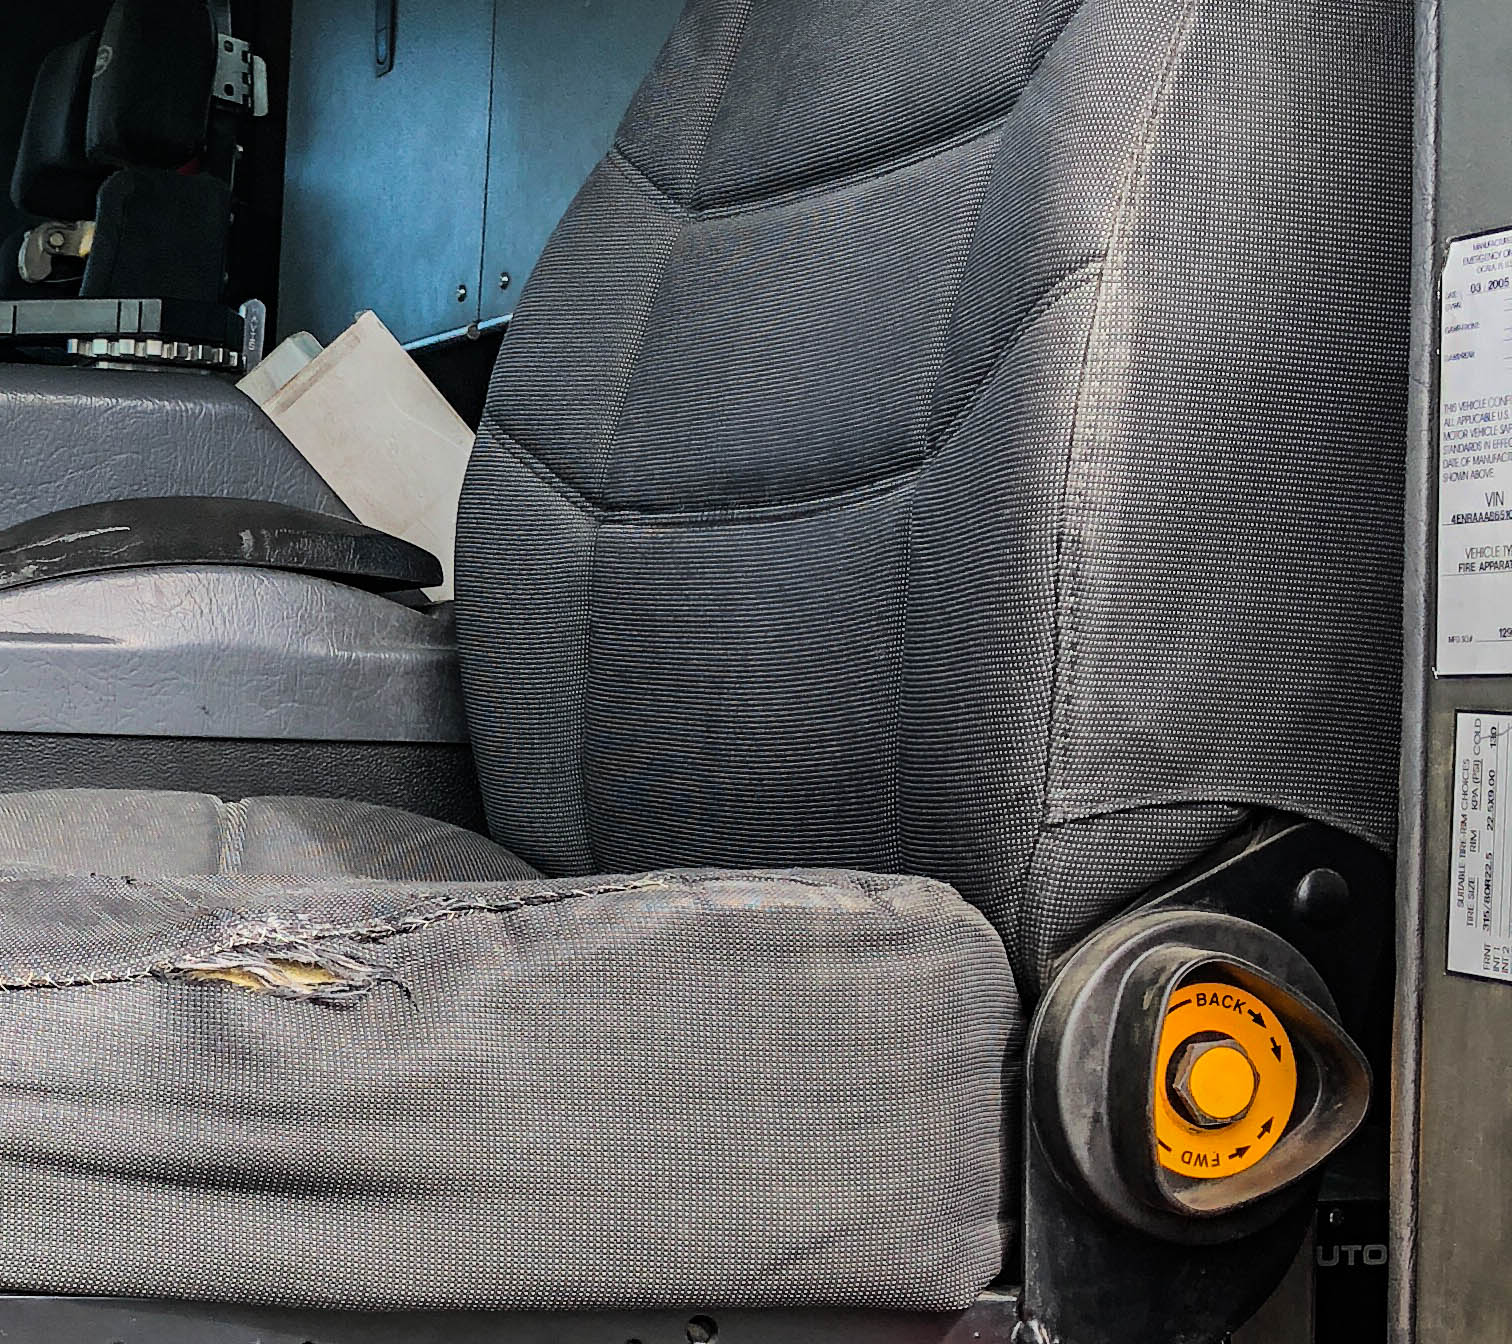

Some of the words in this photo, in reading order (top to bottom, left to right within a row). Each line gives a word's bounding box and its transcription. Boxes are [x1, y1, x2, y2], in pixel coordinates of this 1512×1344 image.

[1488, 277, 1509, 291] 2005
[1459, 398, 1486, 411] VEHICLE
[1470, 424, 1497, 438] VEHICLE
[1484, 490, 1505, 507] VIN
[1465, 545, 1500, 560] VEHICLE
[1458, 562, 1476, 573] FIRE
[1473, 718, 1481, 755] COLD
[1456, 863, 1465, 908] SUITABLE
[1461, 758, 1469, 810] CHOICES
[1467, 876, 1475, 900] SIZE
[1466, 903, 1474, 927] TIRE
[1482, 943, 1490, 970] FRNT
[1196, 993, 1246, 1014] BACK
[1181, 1151, 1220, 1167] FWD
